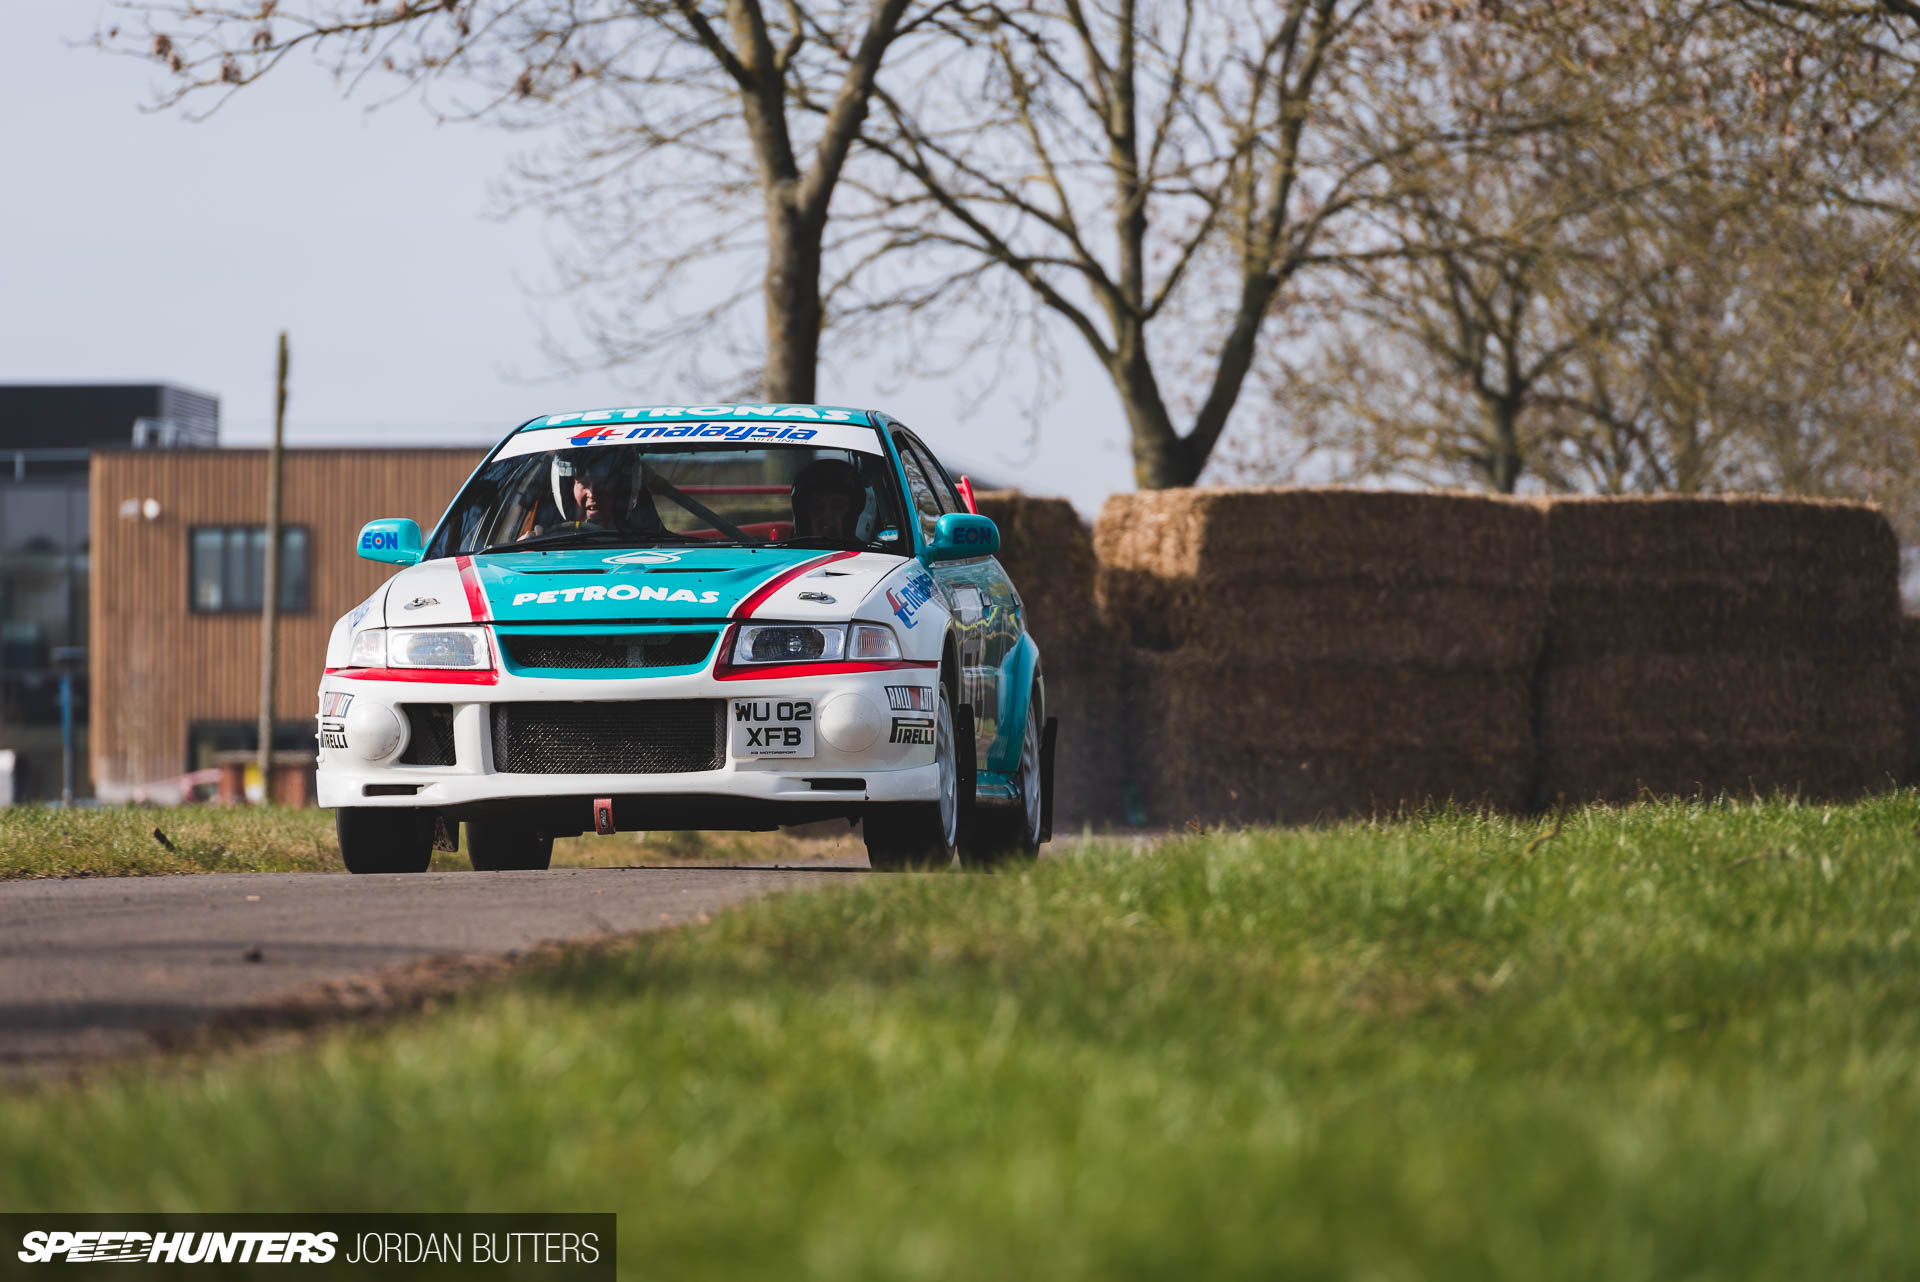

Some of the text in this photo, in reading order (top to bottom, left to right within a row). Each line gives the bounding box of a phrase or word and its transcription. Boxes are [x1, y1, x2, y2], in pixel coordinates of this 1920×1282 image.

[545, 406, 852, 426] PETRONAS
[625, 423, 818, 441] malaysia
[361, 532, 398, 550] EON
[952, 527, 992, 545] EON
[512, 584, 719, 606] PETRONAS
[735, 701, 812, 722] WU 02
[746, 726, 802, 747] XFB
[889, 717, 934, 745] PIRELLI
